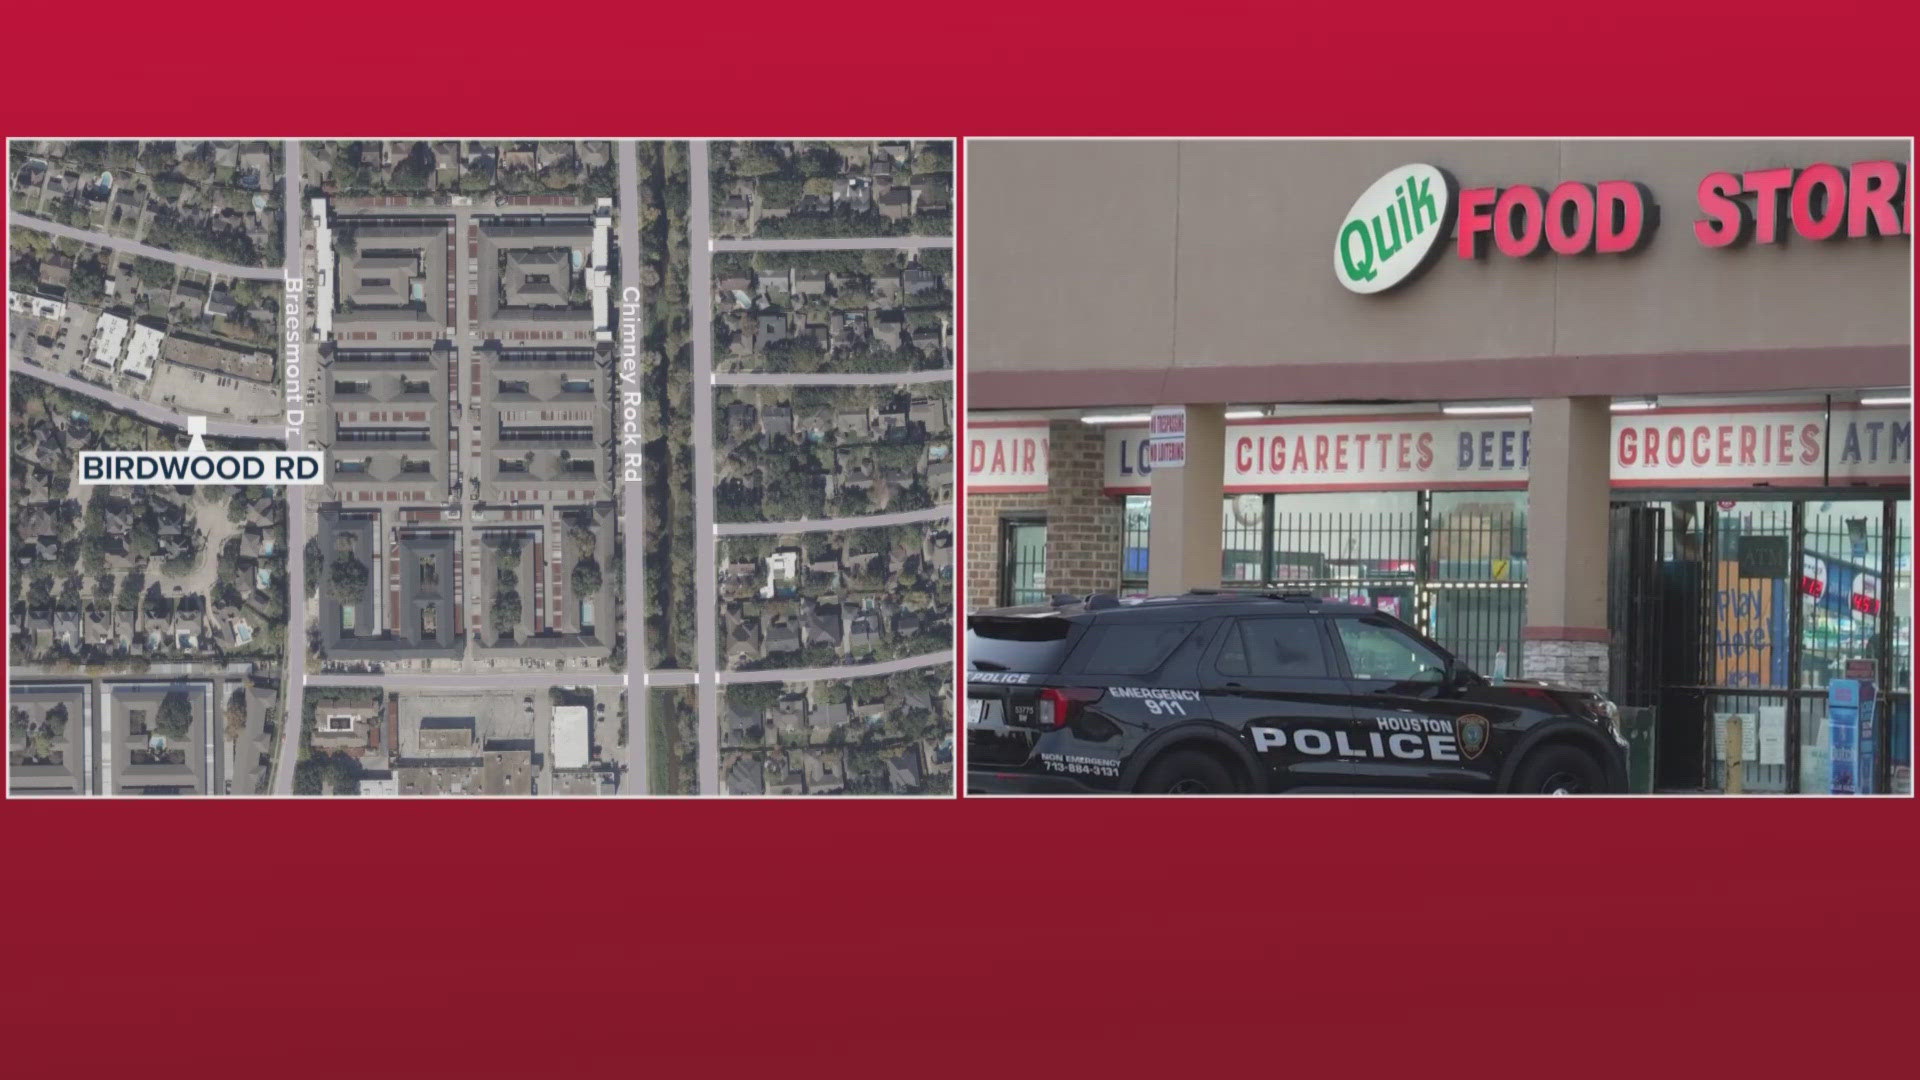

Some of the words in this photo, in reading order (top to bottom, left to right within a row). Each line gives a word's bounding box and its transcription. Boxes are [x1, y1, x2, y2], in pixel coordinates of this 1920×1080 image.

[1457, 180, 1645, 260] FOOD
[1693, 160, 1911, 249] STOR
[1340, 175, 1438, 282] Quik
[1235, 431, 1433, 475] CIGARETTES
[1618, 423, 1821, 468] GROCERIES
[1840, 421, 1911, 464] ATM
[1716, 588, 1762, 621] Play
[971, 671, 1030, 684] POLICE
[1108, 686, 1200, 701] EMERGENCY
[1145, 699, 1187, 715] 911
[1376, 717, 1454, 734] HOUSTON
[1041, 752, 1064, 762] NON
[1065, 755, 1121, 767] EMERGENCY
[1251, 727, 1460, 761] POLICE
[1044, 761, 1119, 777] 713-884-3131
